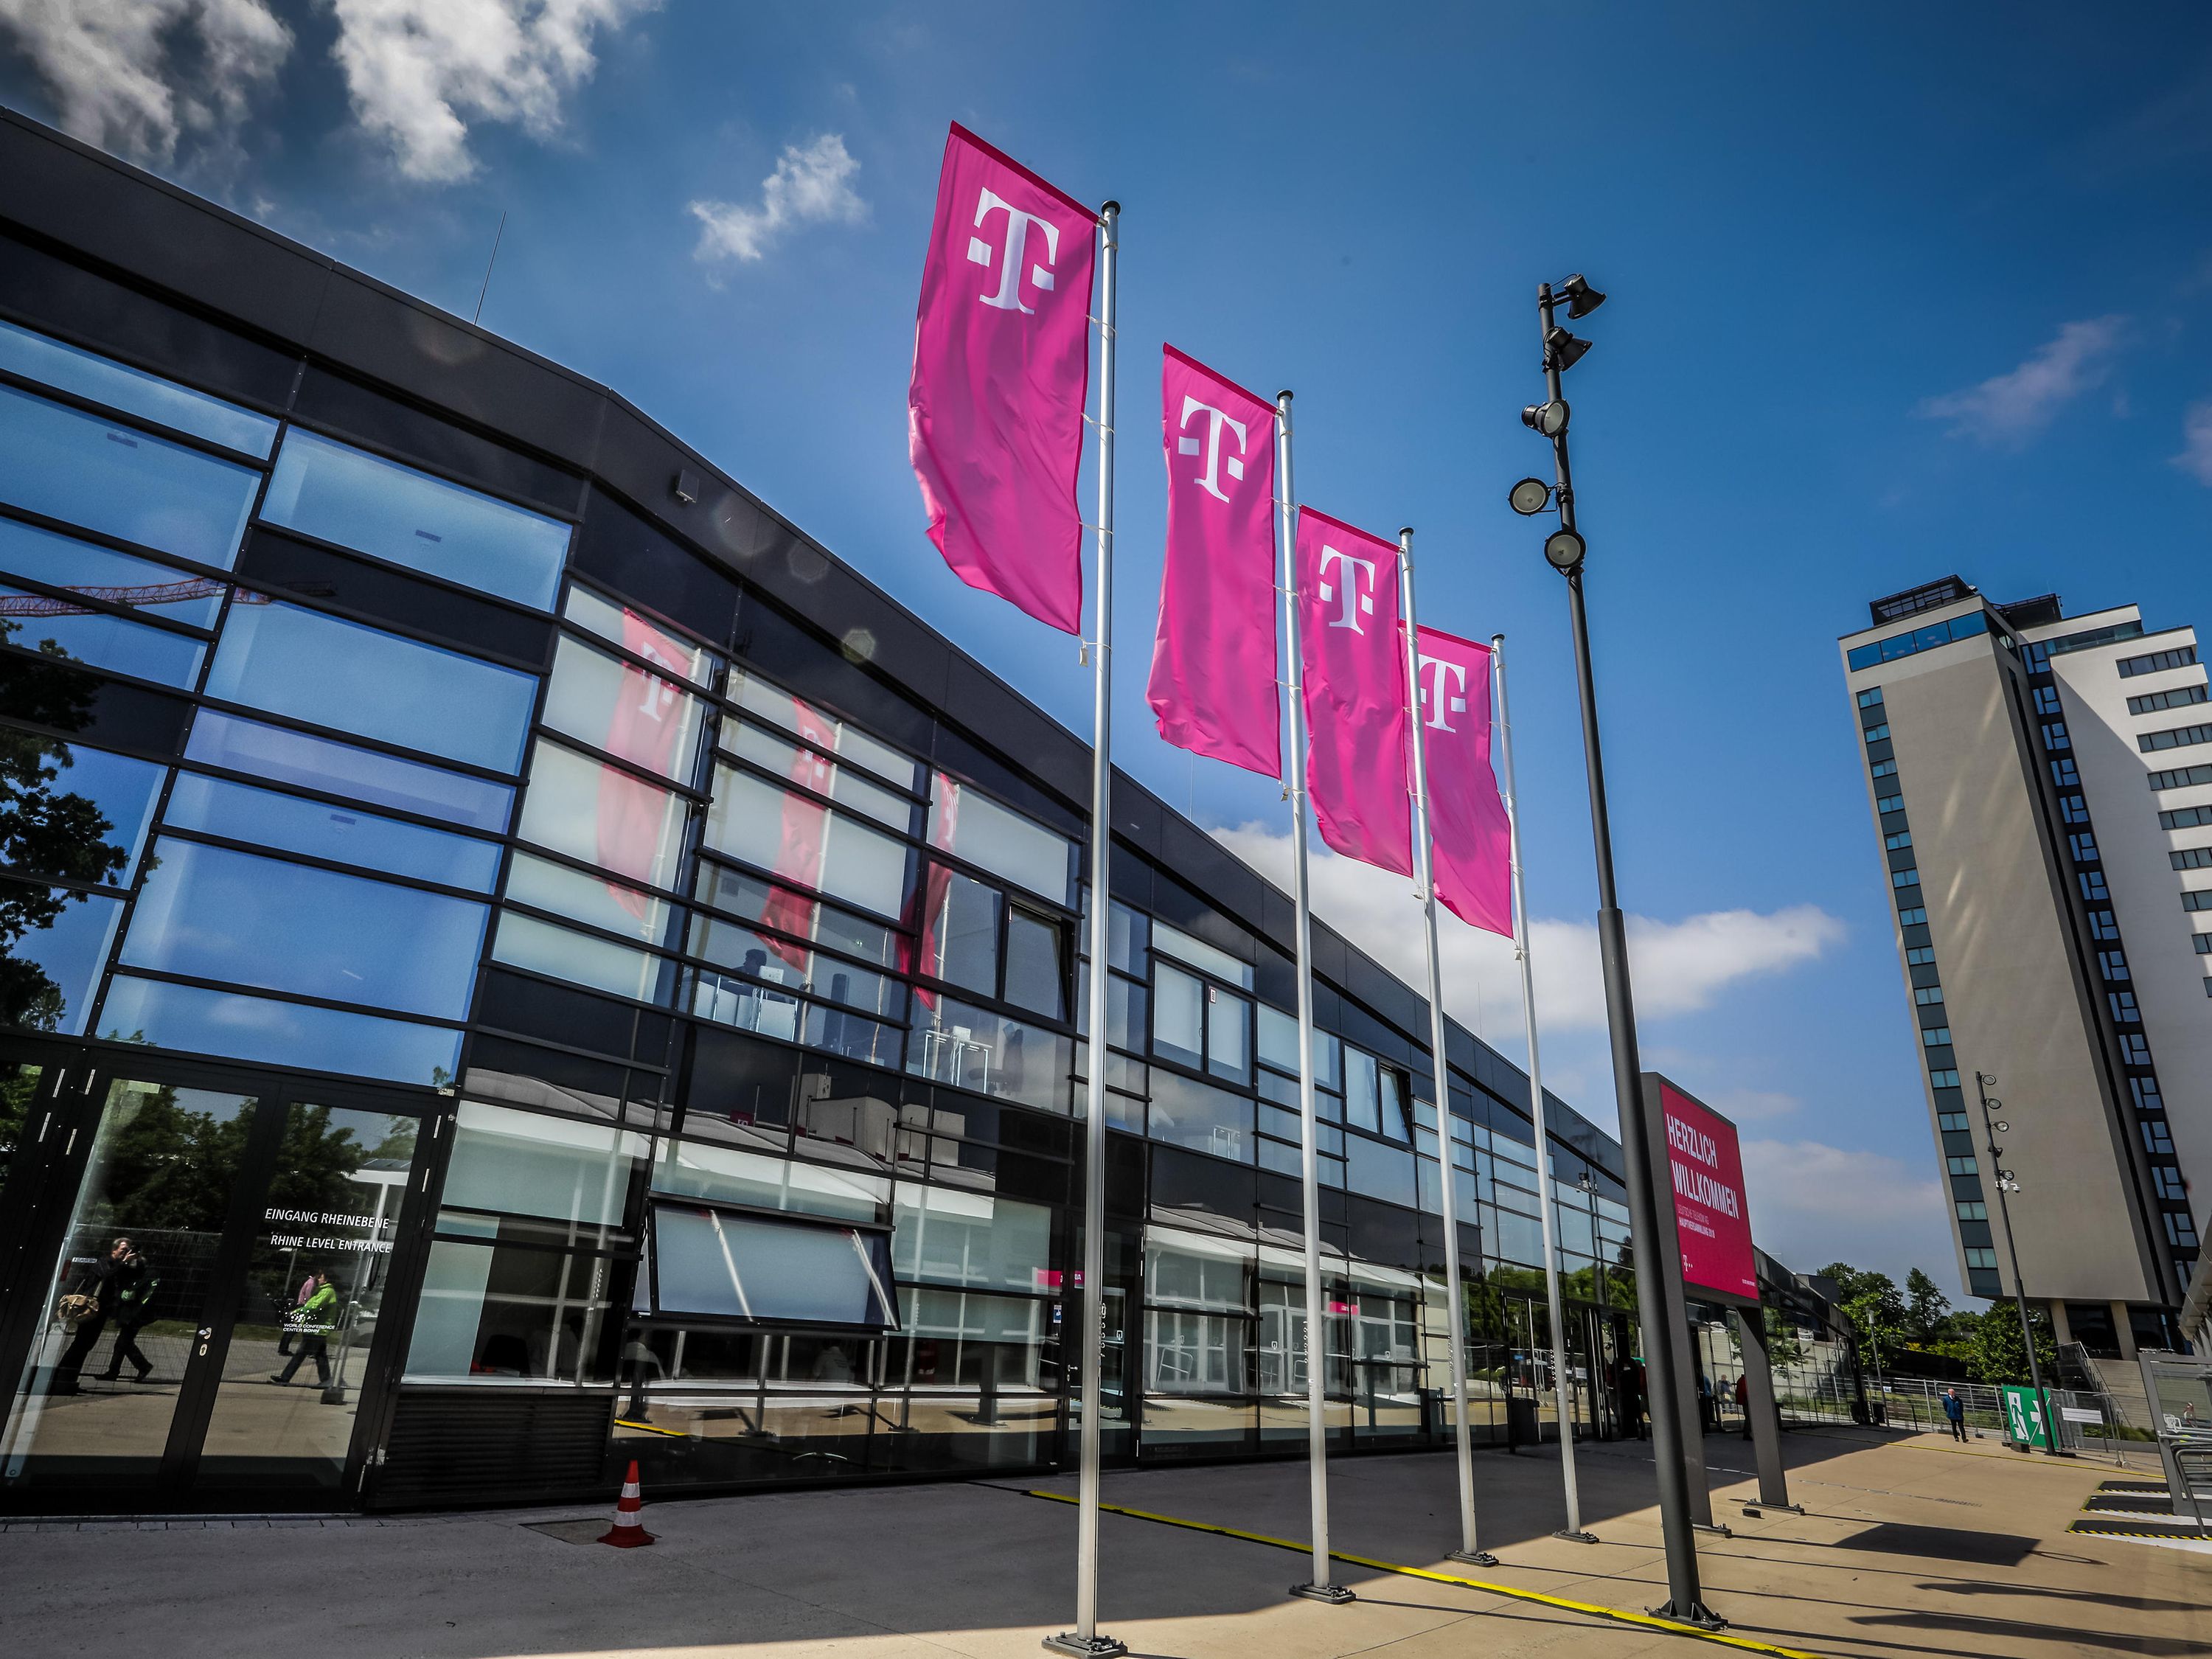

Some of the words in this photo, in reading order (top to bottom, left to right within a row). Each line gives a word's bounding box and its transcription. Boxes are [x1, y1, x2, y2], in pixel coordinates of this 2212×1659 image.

[967, 187, 1060, 315] T
[1178, 394, 1247, 504] T
[1319, 544, 1375, 636] T
[1419, 653, 1466, 733] T
[1666, 1113, 1718, 1169] HERZLICH
[265, 1208, 319, 1223] EINGANG
[321, 1213, 390, 1229] RHEINEBENE
[1671, 1159, 1739, 1220] WILLKOMMEN
[270, 1234, 305, 1247] RHINE
[306, 1237, 335, 1249] LEVEL
[338, 1239, 392, 1253] ENTRANCE
